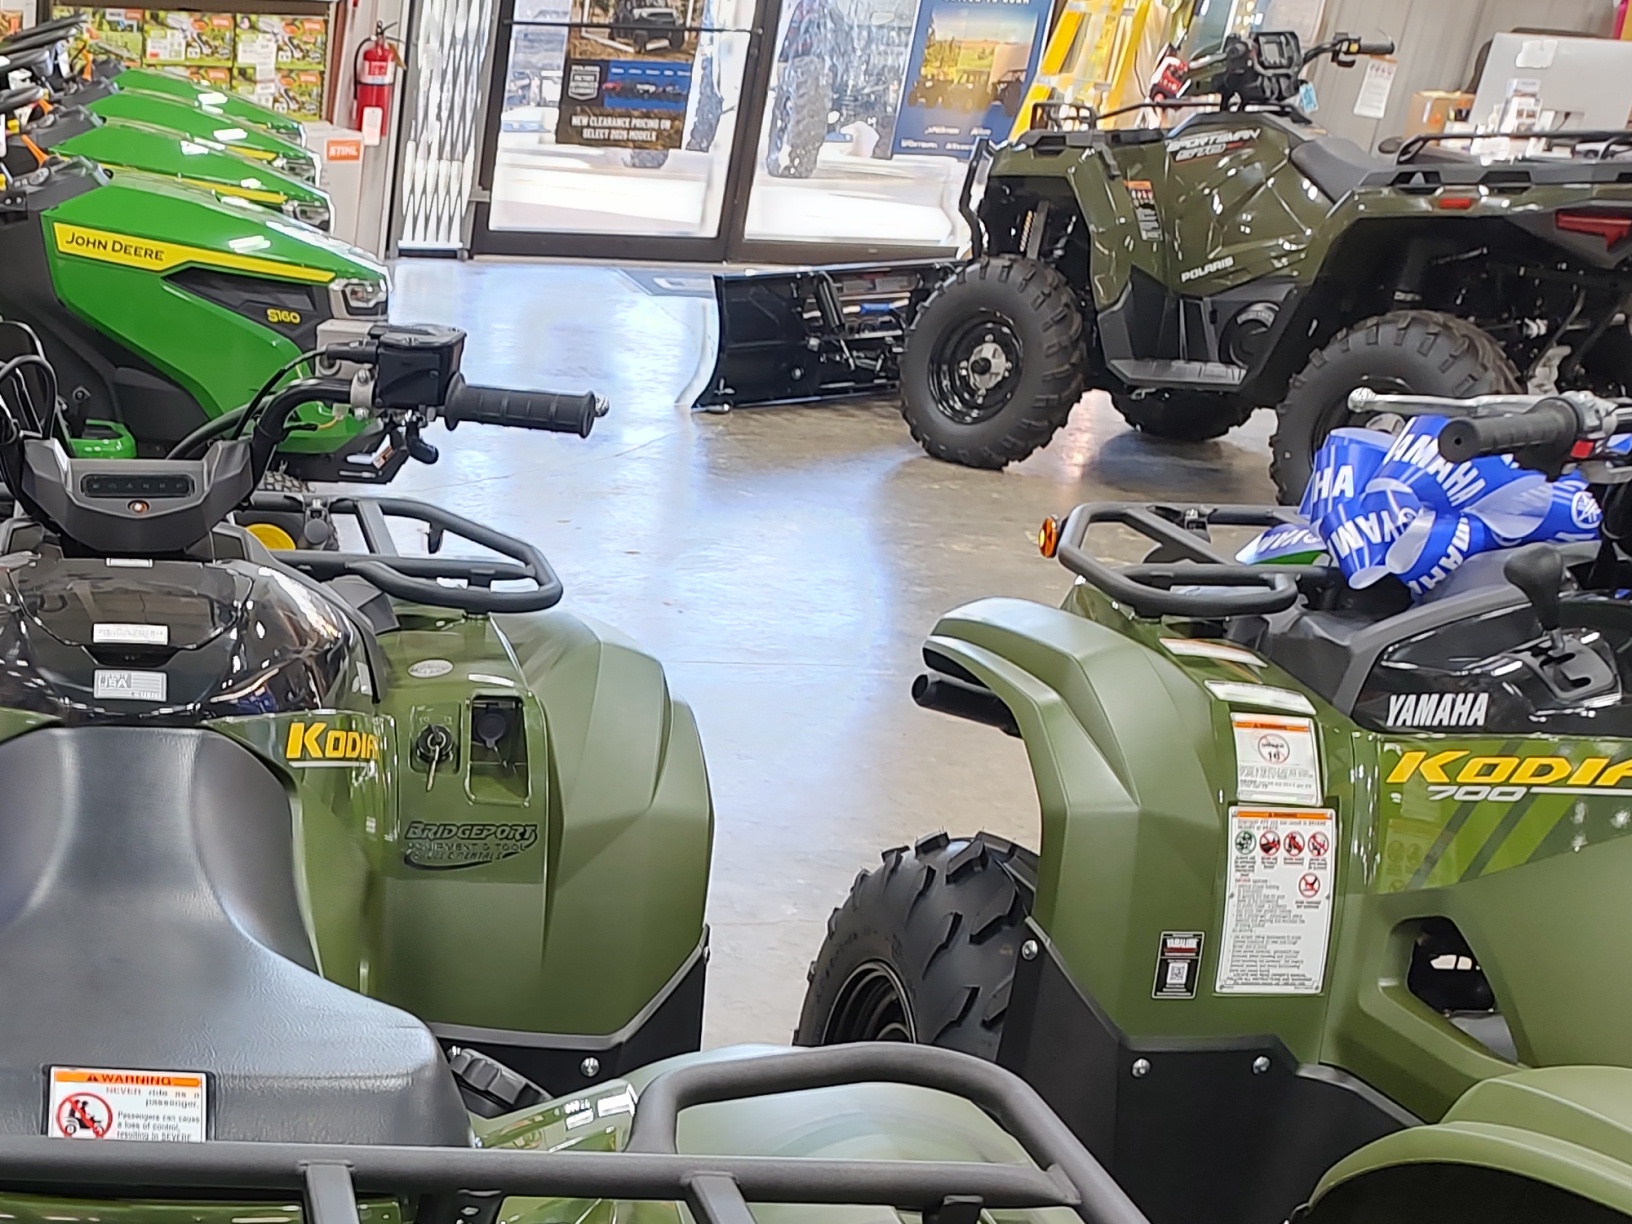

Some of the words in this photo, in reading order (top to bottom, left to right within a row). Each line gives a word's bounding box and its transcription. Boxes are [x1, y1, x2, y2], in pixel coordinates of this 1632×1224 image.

[571, 115, 589, 126] NEW
[589, 116, 631, 128] CLEARANCE
[631, 117, 659, 129] PRICING
[582, 128, 609, 139] SELECT
[628, 131, 657, 142] MODELS
[328, 145, 359, 157] STIHL
[65, 231, 108, 251] JOHN
[110, 240, 165, 262] DEERE
[1181, 256, 1234, 283] POLARIS
[266, 307, 301, 324] S160
[1386, 692, 1489, 727] YAMAHA
[286, 722, 379, 760] KODIA
[1386, 750, 1632, 787] KODIA
[1427, 786, 1528, 802] 700
[405, 821, 538, 841] BRIDGEPORT
[492, 842, 526, 851] TOOL
[101, 1073, 171, 1087] WARNING
[106, 1086, 142, 1096] NEVER
[148, 1088, 168, 1097] ride
[175, 1090, 187, 1098] as
[145, 1099, 199, 1110] passenger.
[118, 1110, 160, 1123] Passengers
[178, 1115, 200, 1124] cause
[124, 1121, 140, 1130] loss
